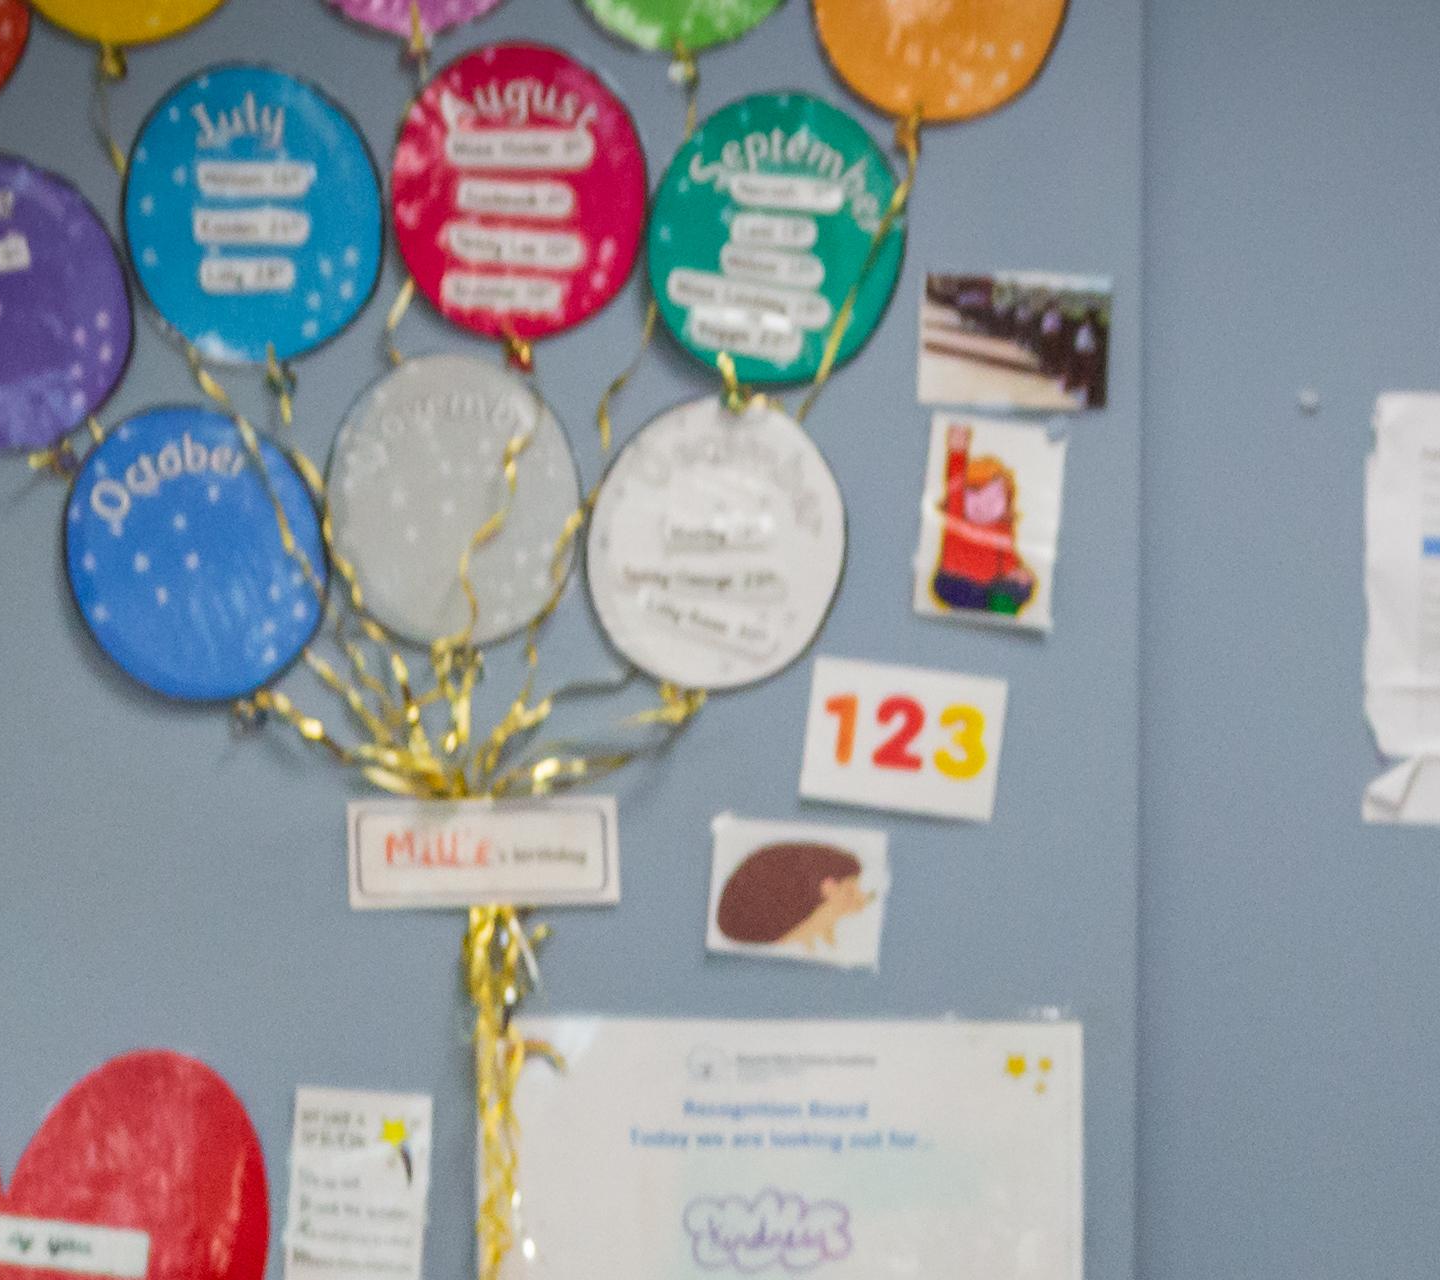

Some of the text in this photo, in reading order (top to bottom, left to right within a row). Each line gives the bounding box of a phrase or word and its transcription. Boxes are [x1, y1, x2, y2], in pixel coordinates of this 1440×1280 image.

[190, 90, 286, 150] July
[689, 123, 885, 233] Septembe
[825, 693, 987, 781] 123
[629, 1126, 690, 1149] Today
[808, 1098, 869, 1120] Board
